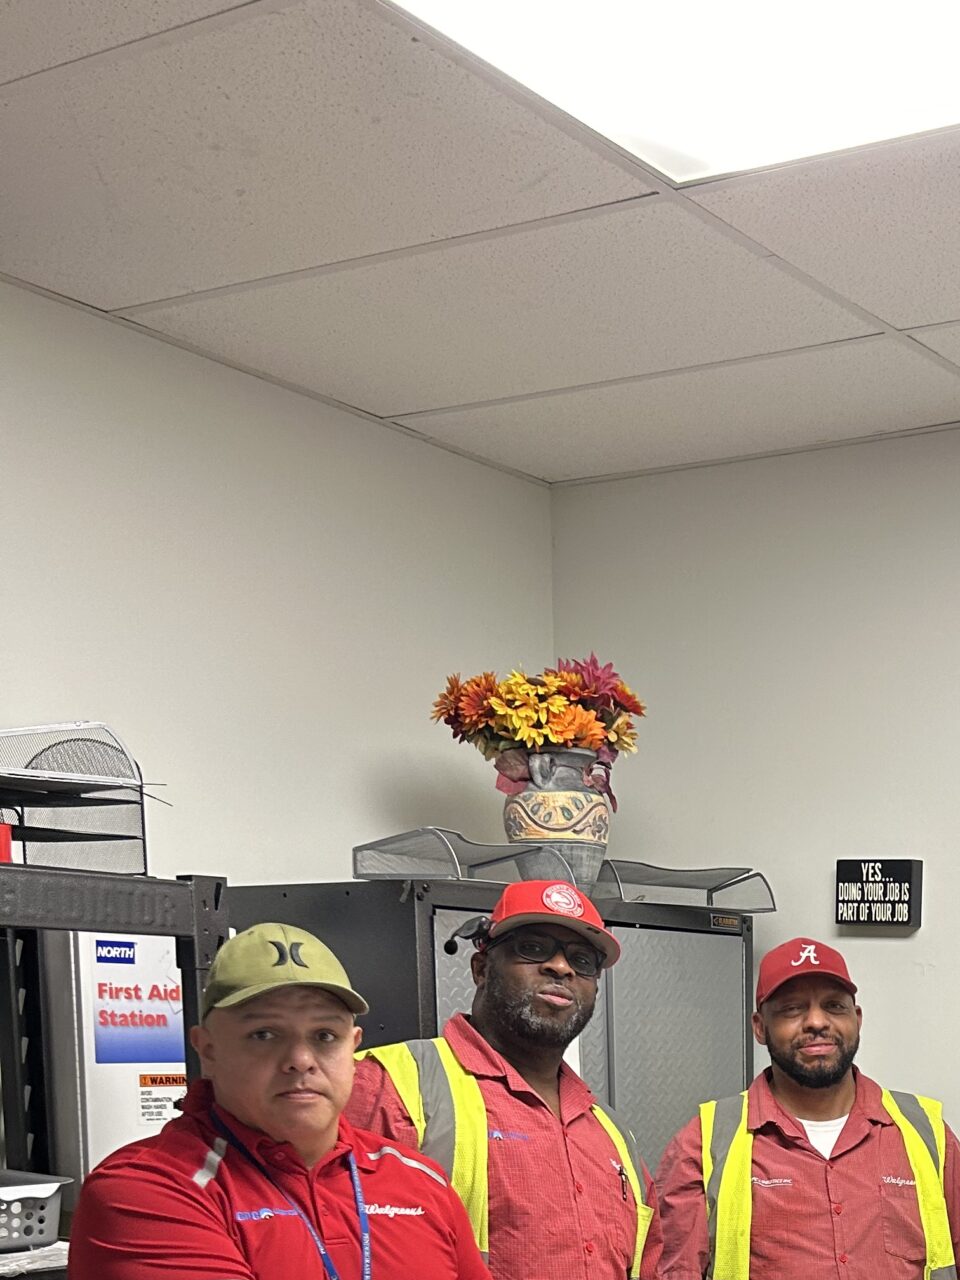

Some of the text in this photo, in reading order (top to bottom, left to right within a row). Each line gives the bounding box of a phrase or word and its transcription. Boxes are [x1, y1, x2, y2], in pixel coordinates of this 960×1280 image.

[861, 862, 893, 881] YES...
[838, 882, 909, 901] DOING YOUR JOB IS
[838, 902, 908, 921] PART OF YOUR JOB
[97, 946, 133, 959] NORTH
[790, 943, 820, 966] A
[97, 982, 180, 1001] First Aid
[97, 1009, 168, 1028] Station
[150, 1076, 187, 1085] WARNIN
[882, 1176, 916, 1187] Walgree
